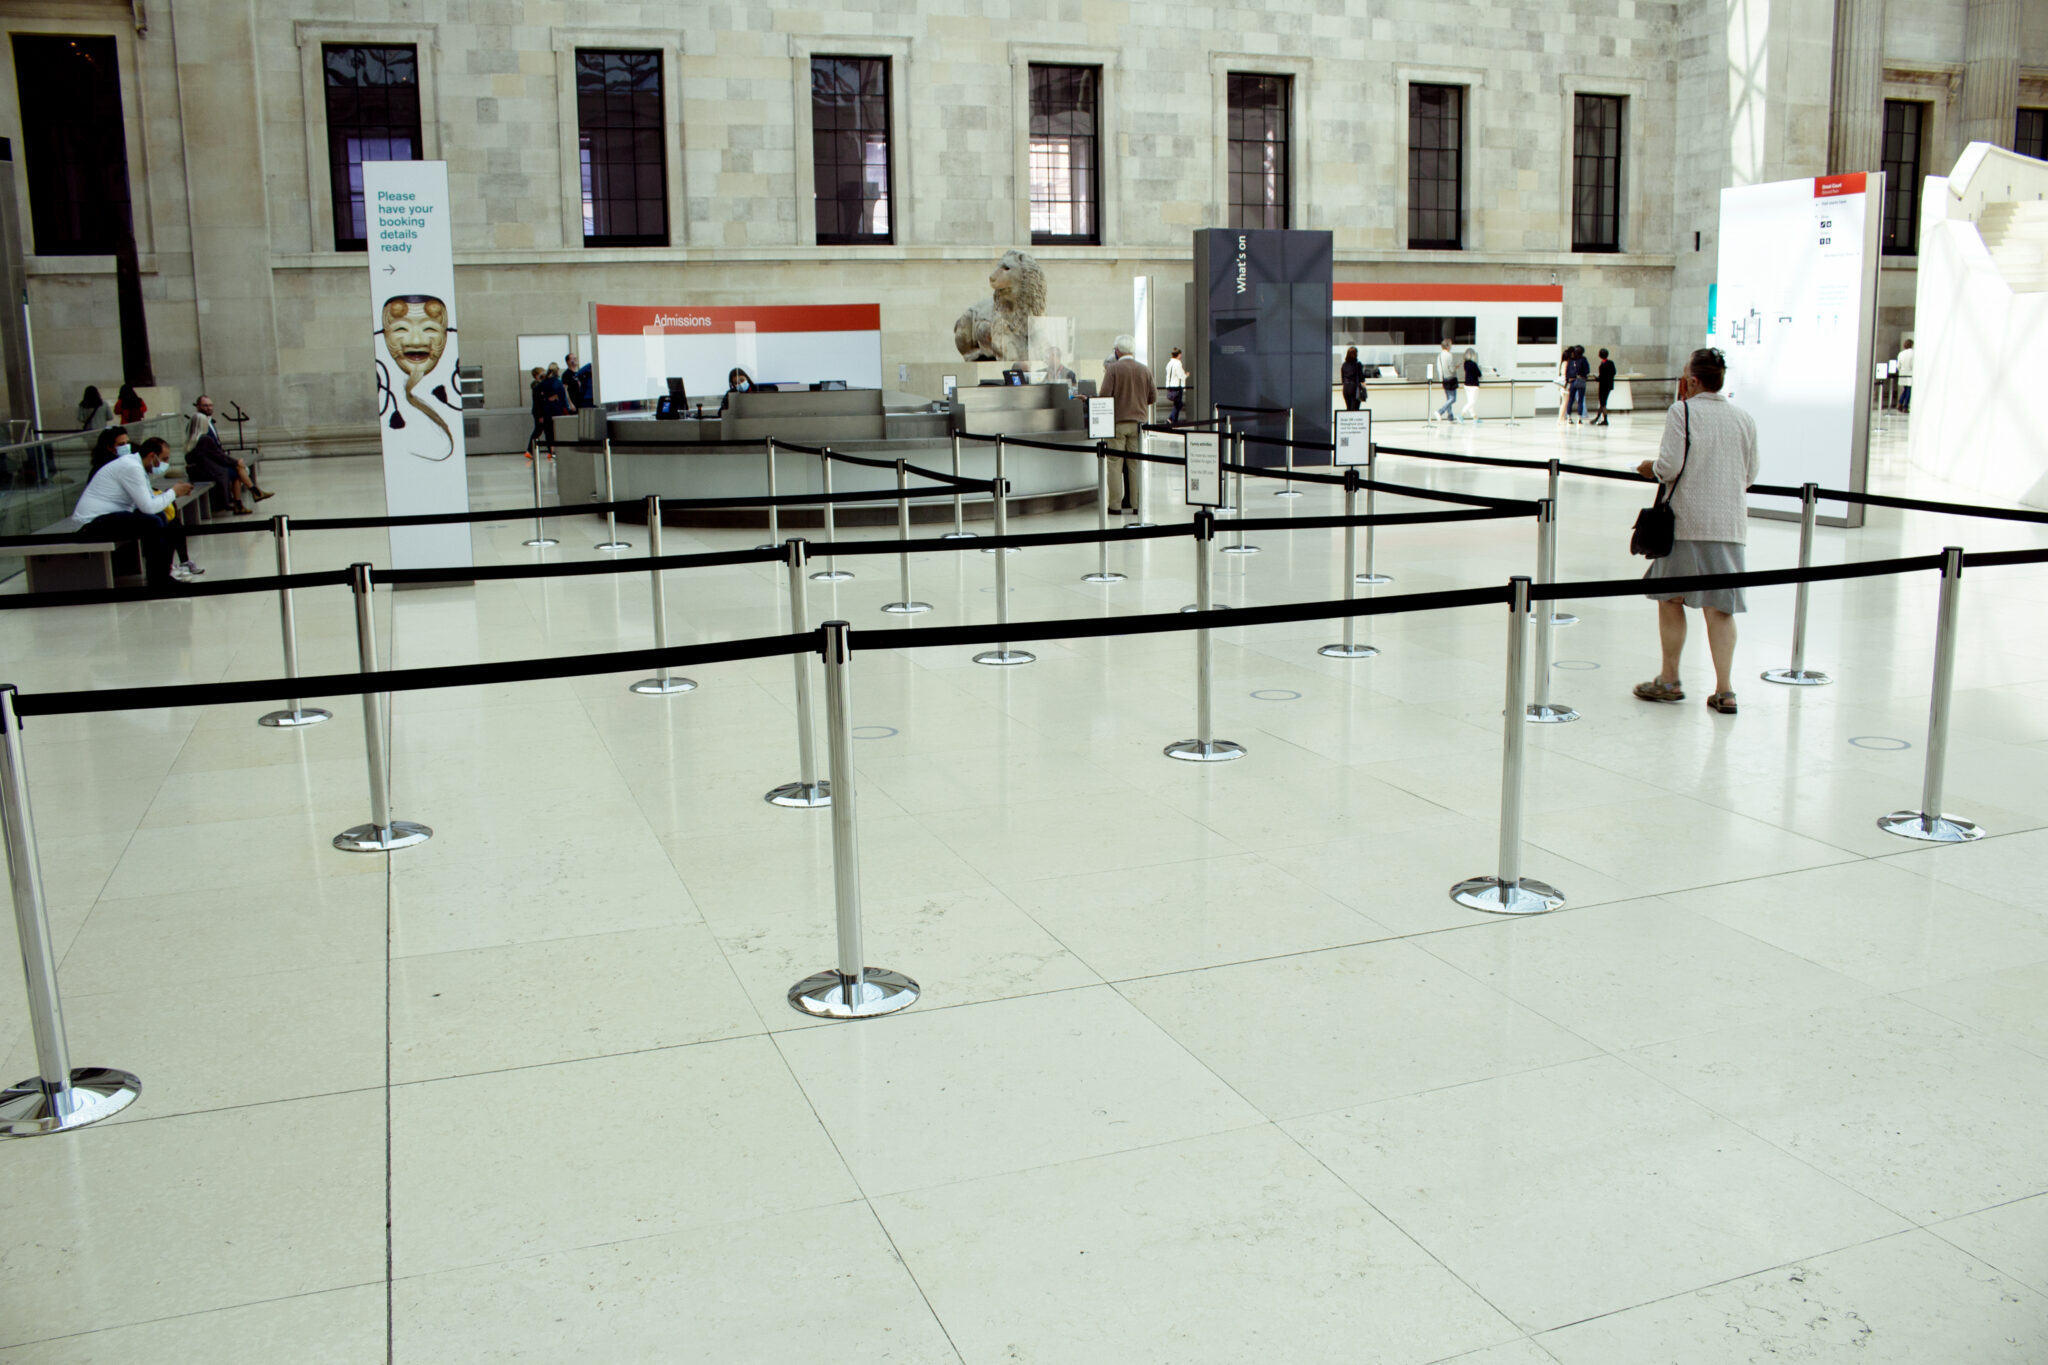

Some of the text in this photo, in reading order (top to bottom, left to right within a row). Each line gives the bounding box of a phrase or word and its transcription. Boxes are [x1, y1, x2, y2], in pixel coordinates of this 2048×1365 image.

[377, 191, 416, 201] Please
[378, 204, 434, 216] have your
[379, 216, 425, 228] booking
[380, 229, 418, 240] details
[381, 241, 412, 253] ready
[1236, 235, 1247, 294] What's on
[653, 313, 712, 327] Admissions
